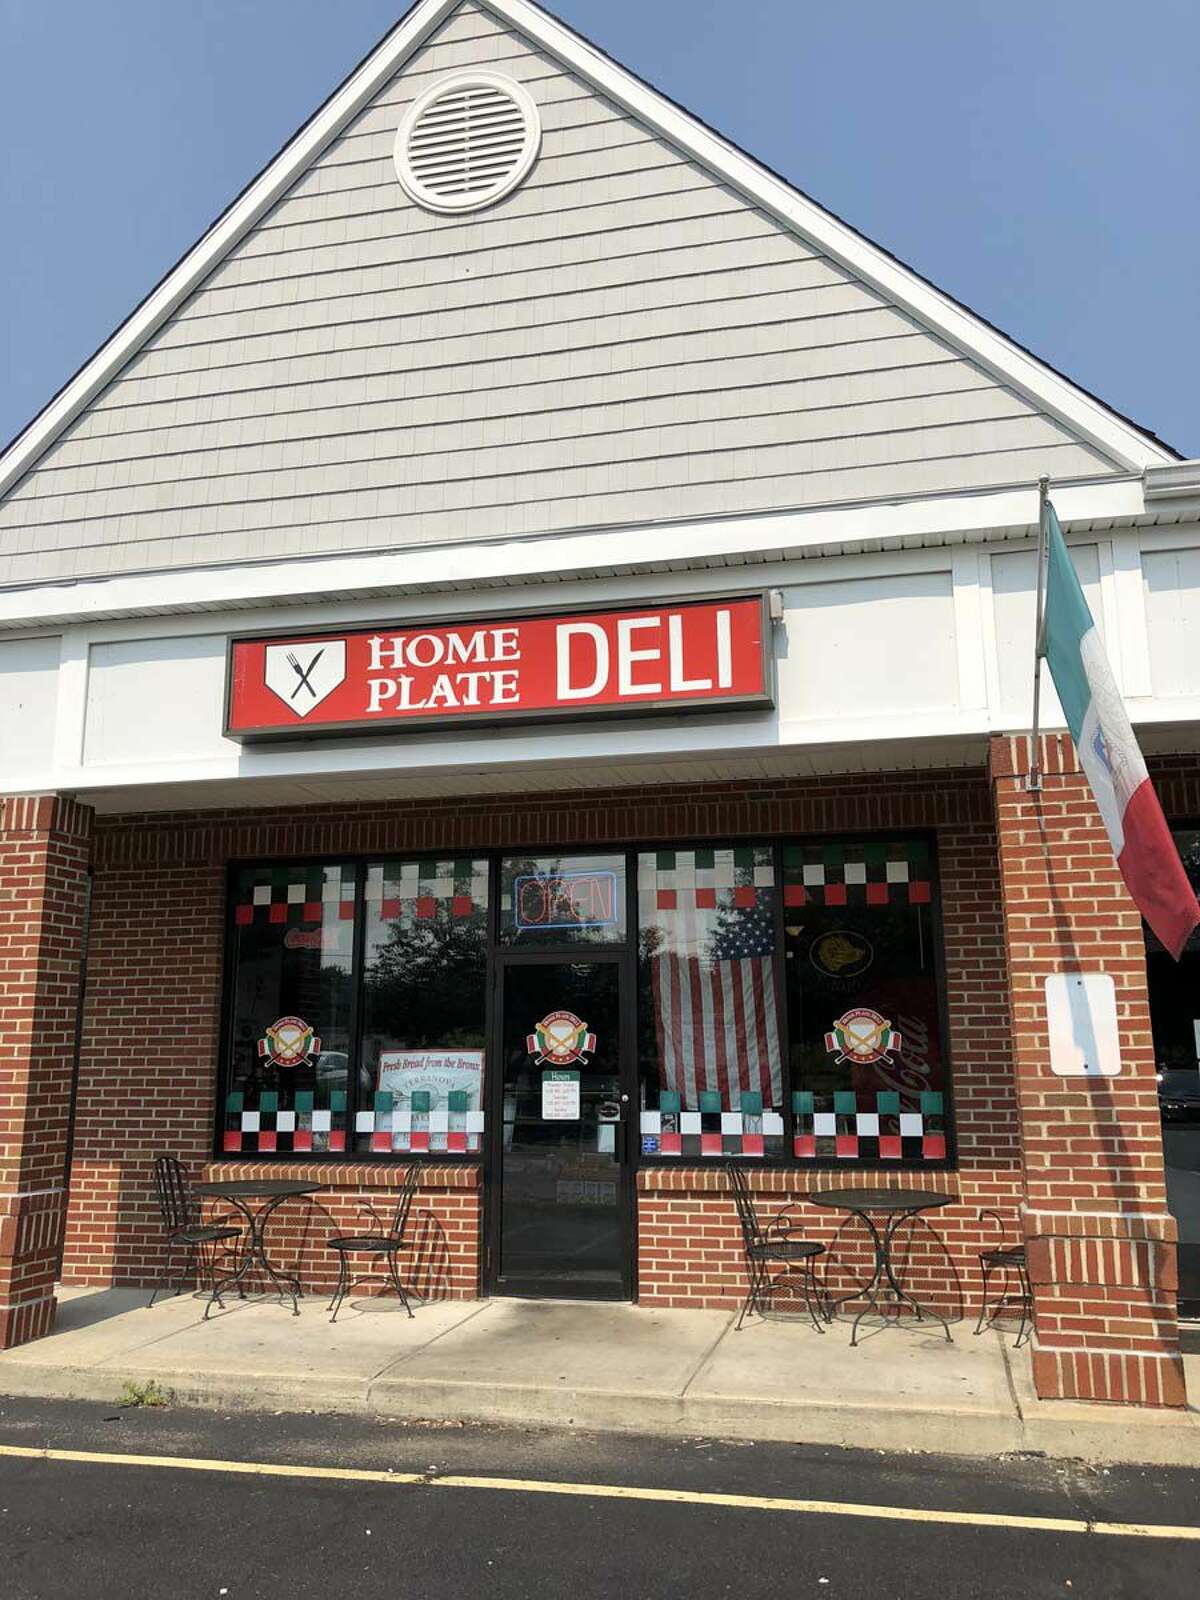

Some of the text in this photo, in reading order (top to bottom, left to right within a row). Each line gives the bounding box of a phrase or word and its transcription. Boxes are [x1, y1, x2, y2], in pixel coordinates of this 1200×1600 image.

[367, 628, 521, 672] HOME
[556, 610, 733, 701] DELI
[365, 668, 521, 713] PLATE
[520, 878, 612, 924] OPEN
